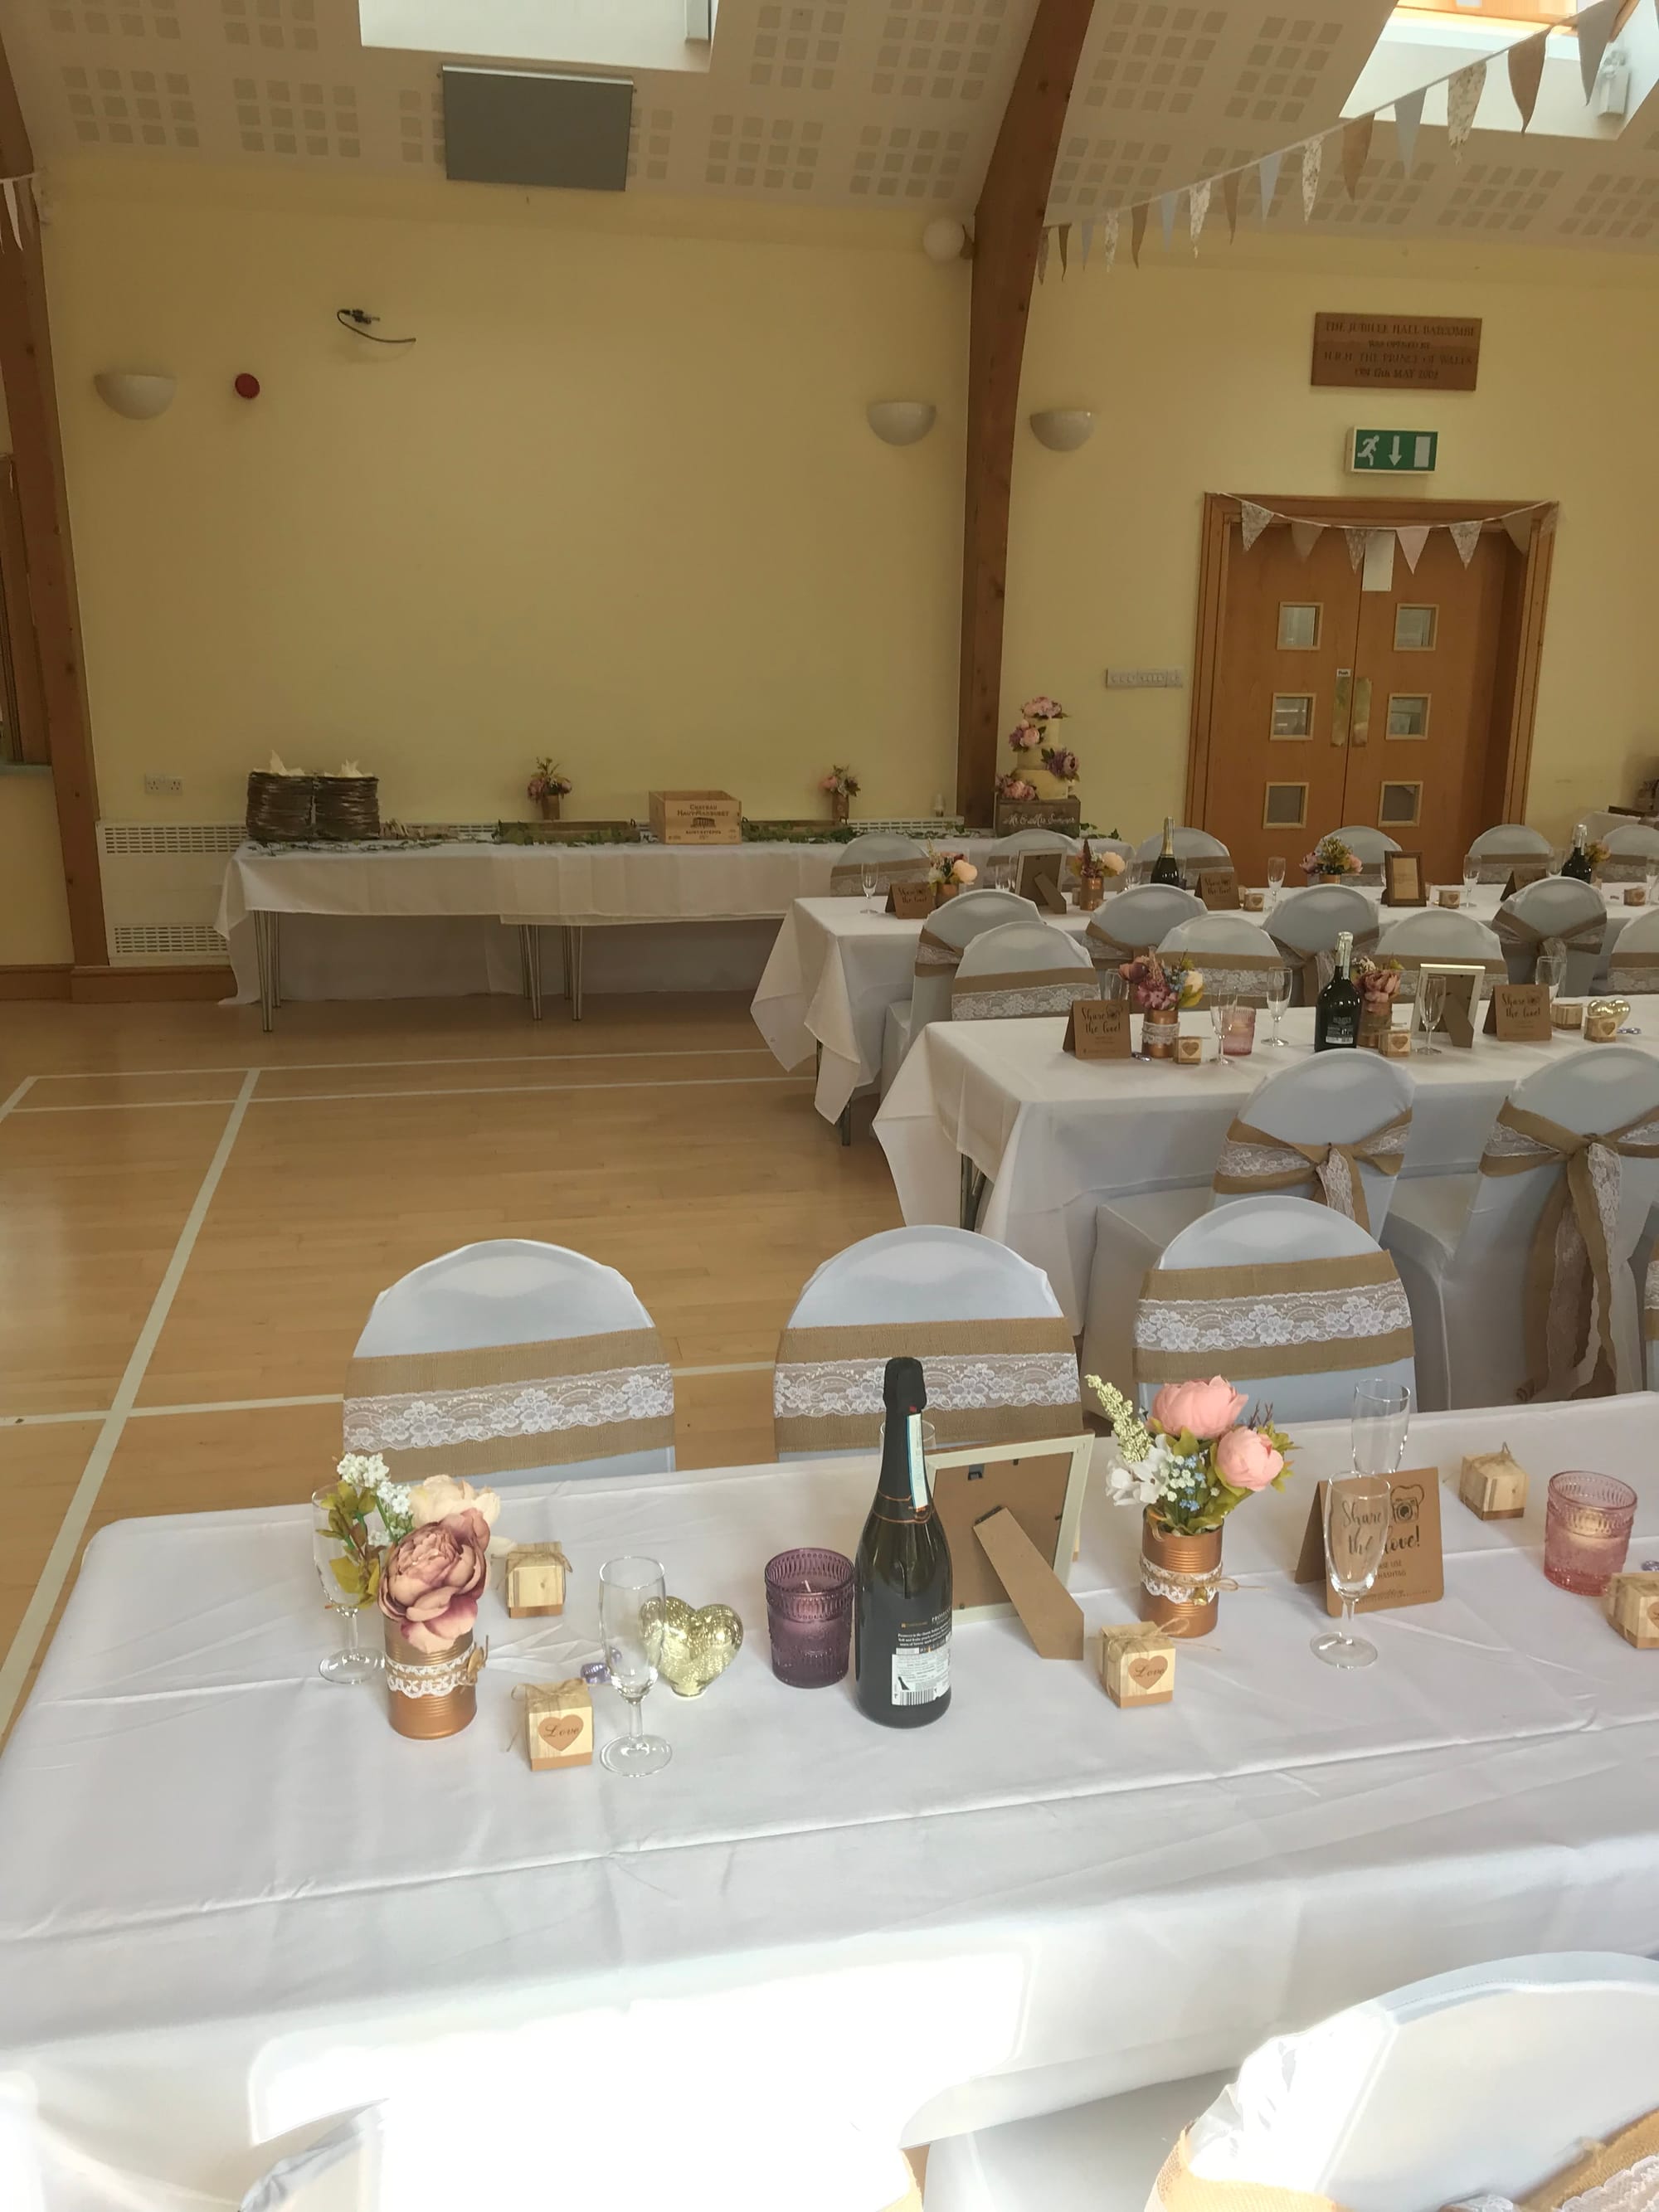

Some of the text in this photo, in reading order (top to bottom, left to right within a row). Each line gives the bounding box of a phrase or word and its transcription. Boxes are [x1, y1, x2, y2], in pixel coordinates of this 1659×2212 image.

[1326, 321, 1345, 333] THE
[1392, 324, 1420, 334] HALL
[1360, 352, 1378, 363] THE
[1383, 353, 1418, 364] PRINCE
[1439, 355, 1473, 366] WALES
[1394, 369, 1415, 379] MAY
[1085, 1021, 1097, 1033] the
[1341, 1500, 1382, 1527] Share
[1348, 1527, 1374, 1554] the
[1134, 1665, 1165, 1678] Love
[543, 1723, 579, 1738] Love
